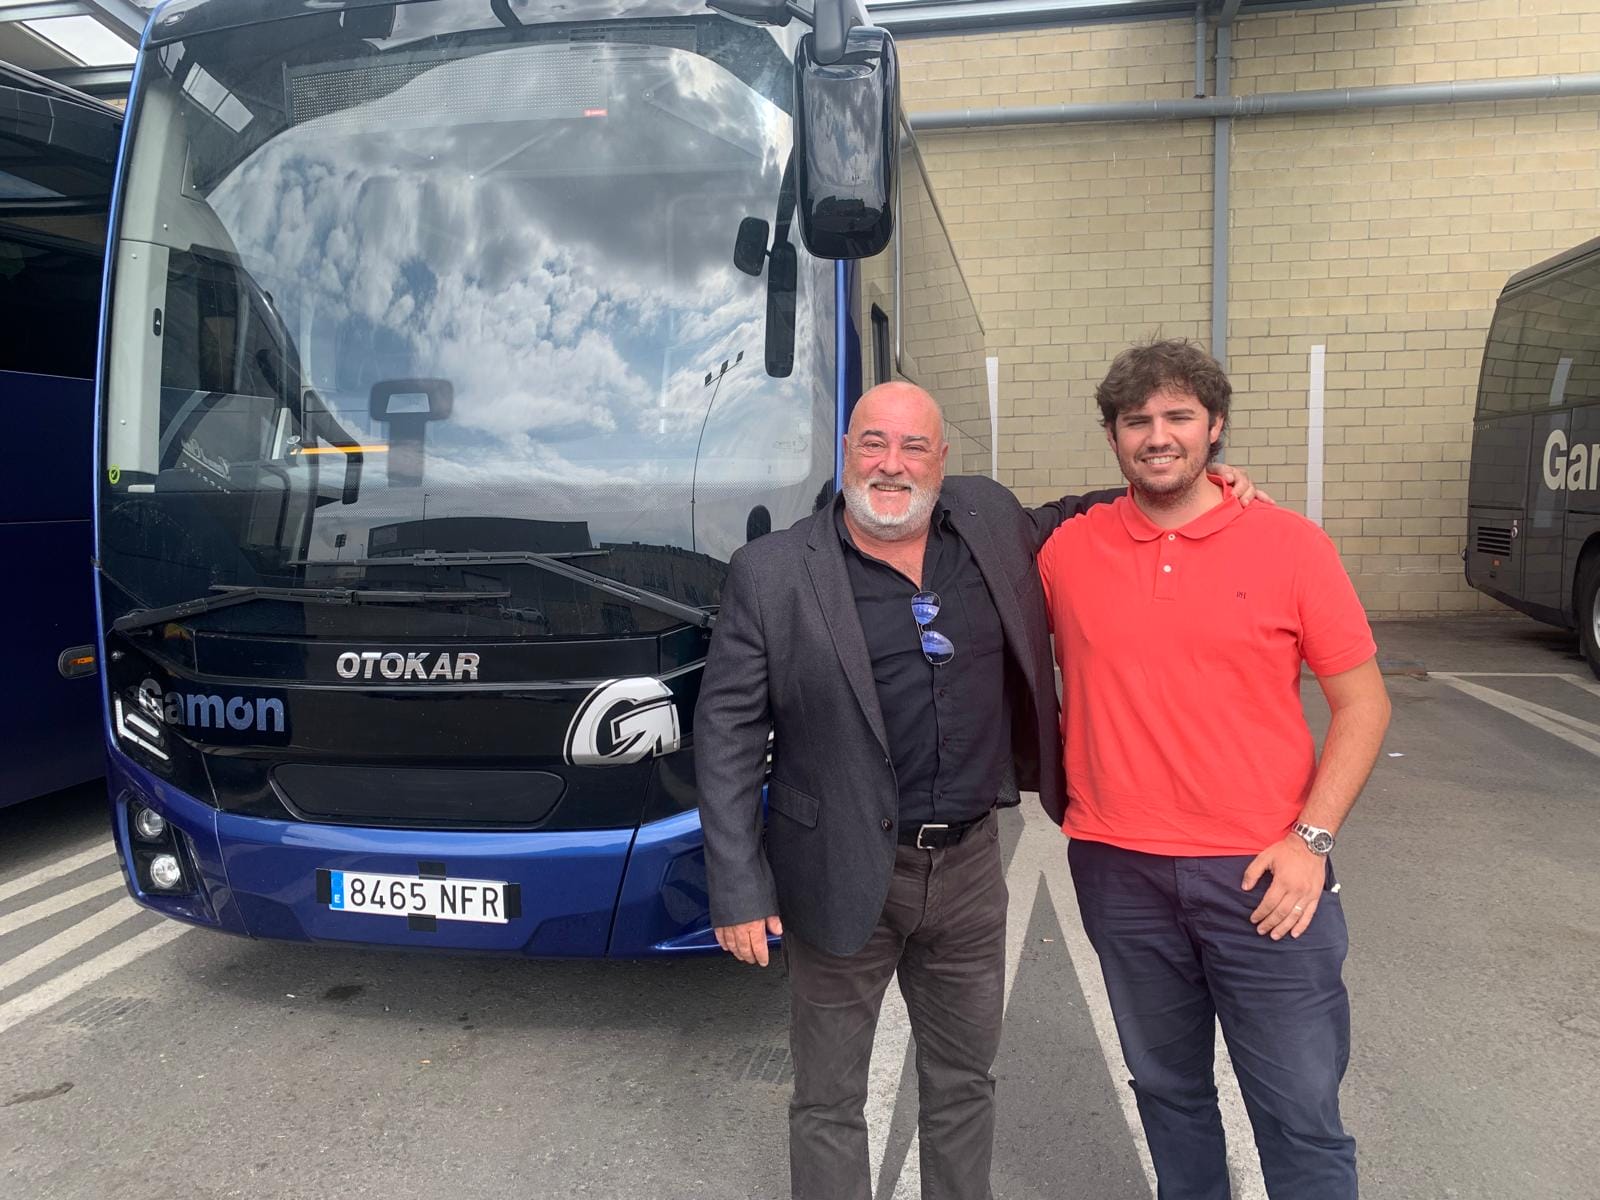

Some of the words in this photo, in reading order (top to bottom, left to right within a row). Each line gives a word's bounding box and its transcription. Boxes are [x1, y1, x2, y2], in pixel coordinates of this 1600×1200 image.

[336, 652, 480, 680] OTOKAR
[334, 894, 341, 903] E
[350, 878, 426, 911] 8465
[440, 884, 499, 917] NFR
